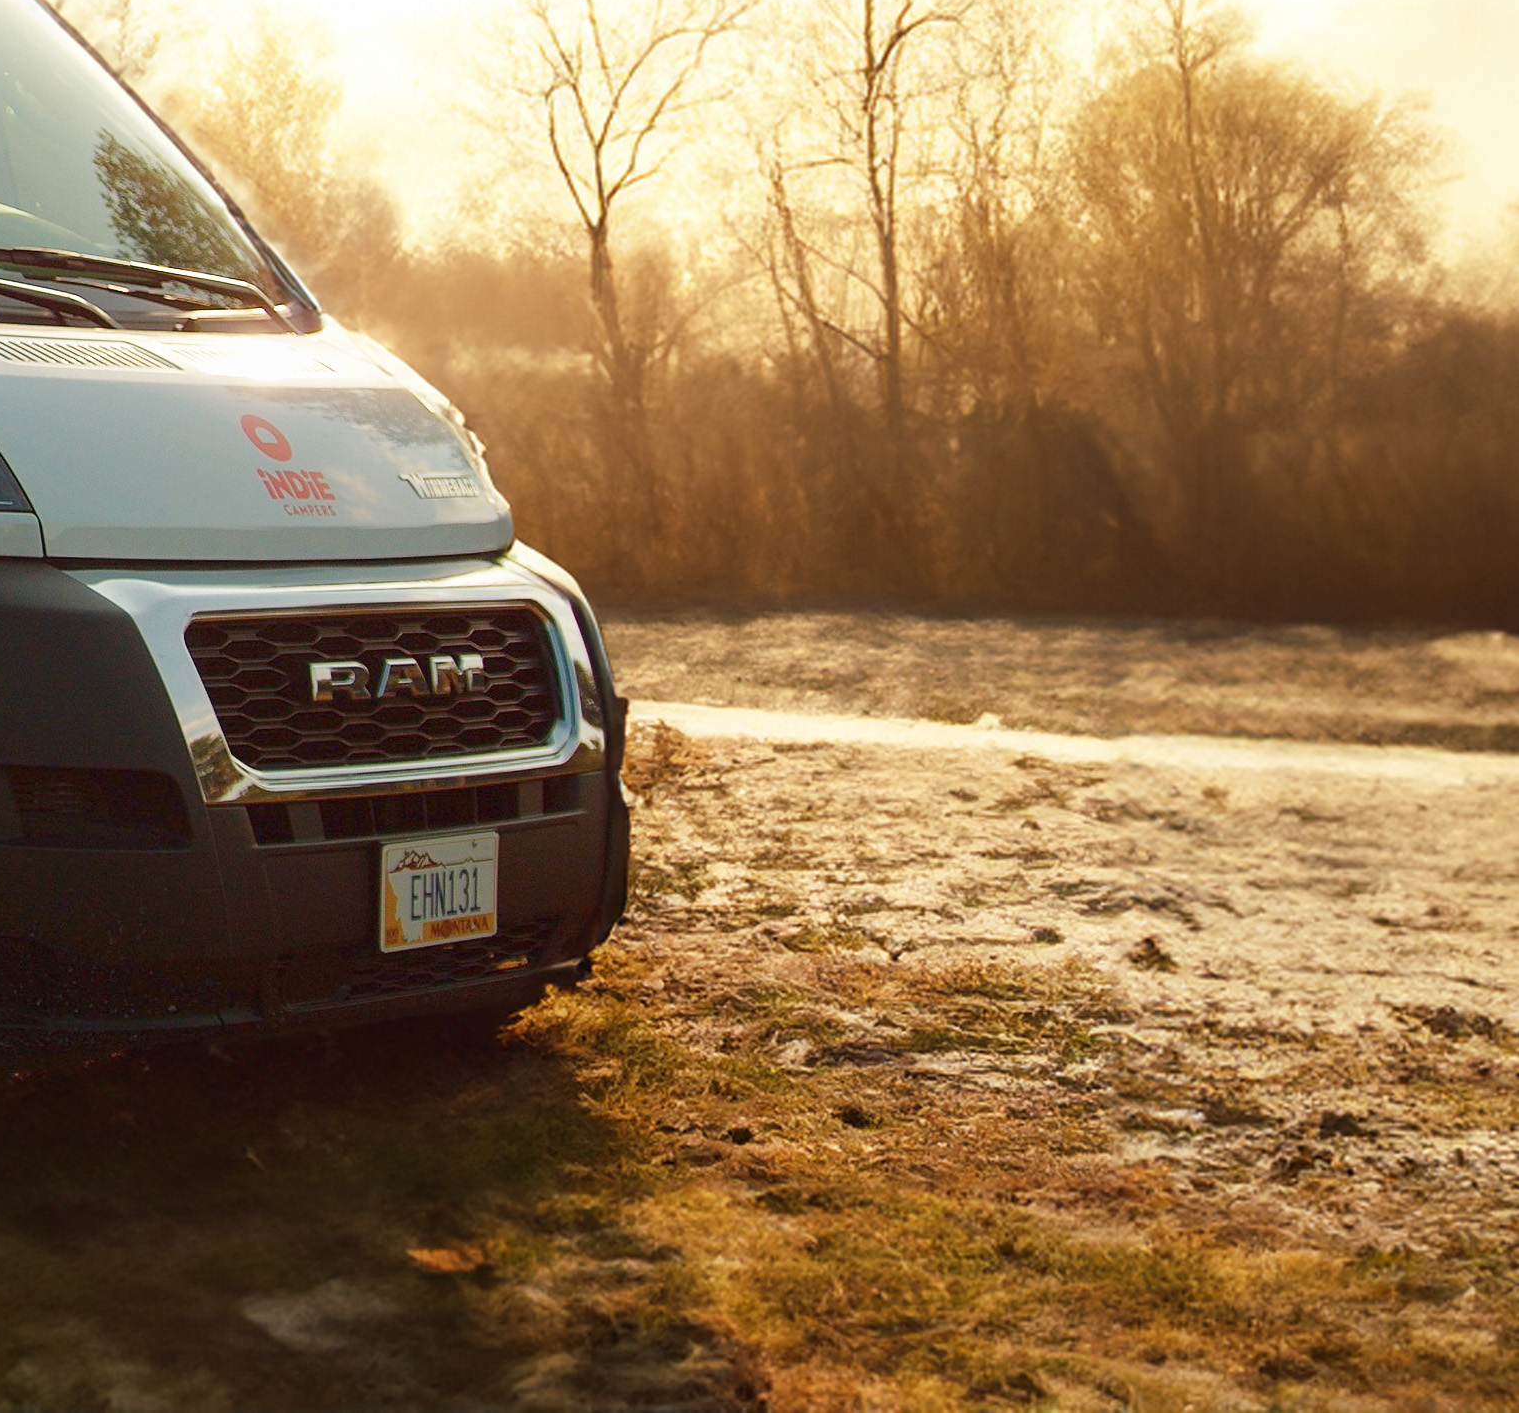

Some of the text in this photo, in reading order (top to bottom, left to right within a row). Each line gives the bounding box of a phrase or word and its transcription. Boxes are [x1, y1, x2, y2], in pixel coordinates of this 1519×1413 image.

[283, 504, 337, 517] CAMPERS
[309, 653, 487, 702] RAM
[410, 867, 482, 921] EHN131
